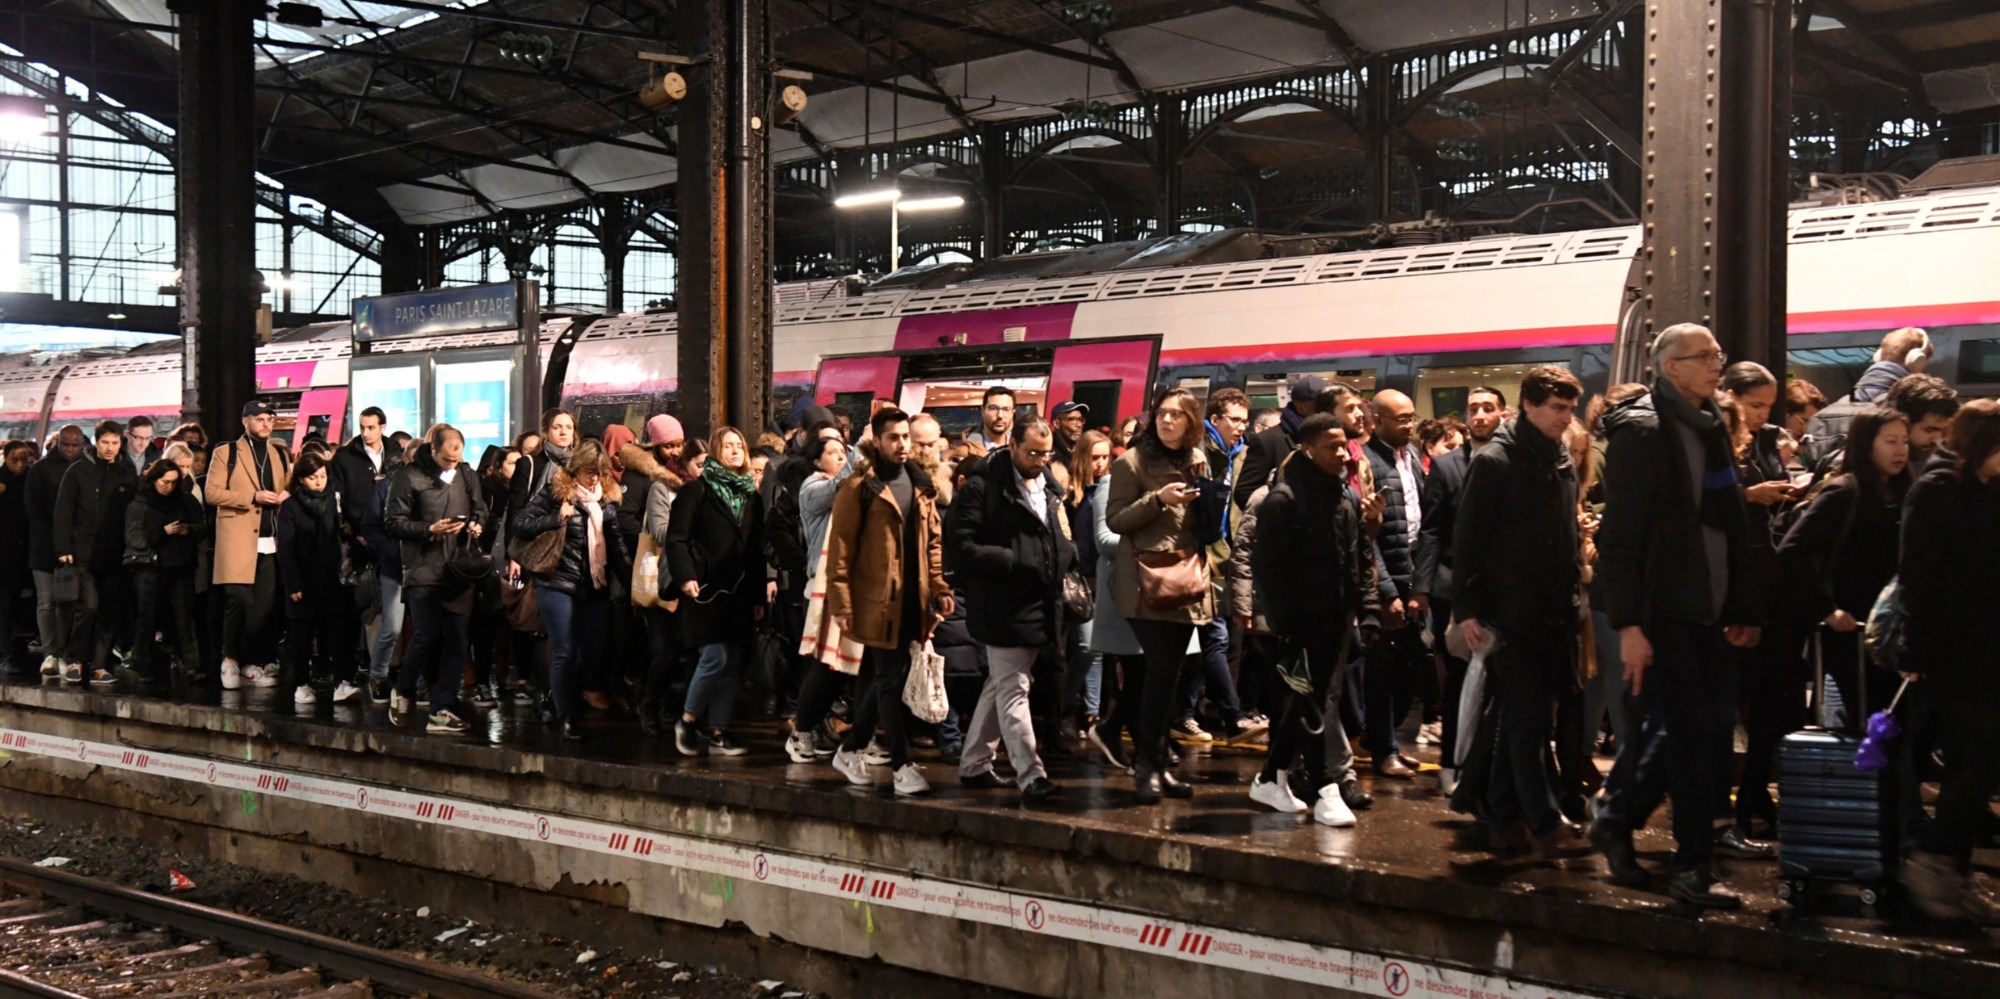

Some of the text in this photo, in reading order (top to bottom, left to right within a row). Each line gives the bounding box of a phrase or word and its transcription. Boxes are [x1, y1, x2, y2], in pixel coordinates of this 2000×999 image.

[395, 297, 510, 324] PARIS SAINT-LAZARE
[896, 886, 919, 898] DANGER
[1213, 940, 1243, 955] DANGER
[1249, 949, 1265, 960] pour
[1266, 952, 1285, 963] votre
[1414, 979, 1424, 989] ne
[1426, 979, 1468, 996] descendez
